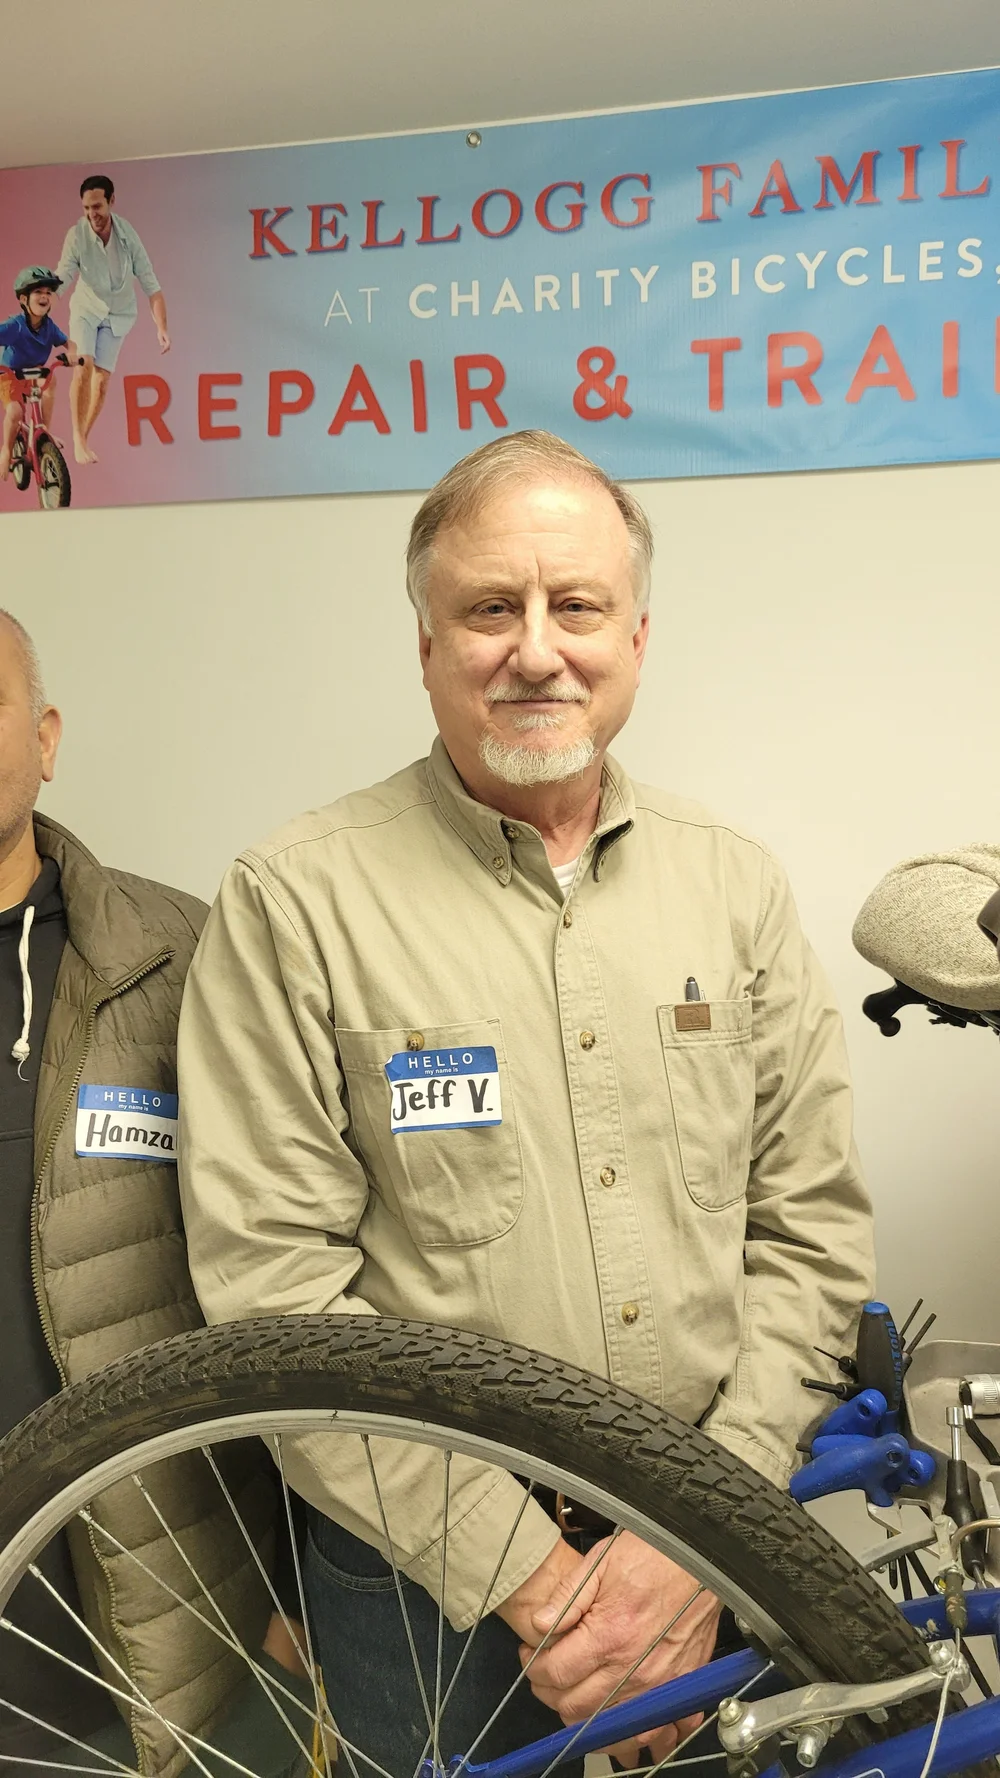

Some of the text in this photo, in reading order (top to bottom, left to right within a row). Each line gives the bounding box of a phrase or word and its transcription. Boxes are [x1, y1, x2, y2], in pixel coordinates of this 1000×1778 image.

[249, 172, 655, 259] KELLOGG
[324, 287, 380, 327] AT
[408, 265, 659, 319] CHARITY
[123, 316, 1000, 446] REPAIR & TRAI
[408, 1052, 473, 1069] HELLO
[435, 1067, 452, 1075] name
[104, 1091, 161, 1108] HELLO
[392, 1078, 494, 1121] Jeff V.
[85, 1112, 174, 1151] Hamza
